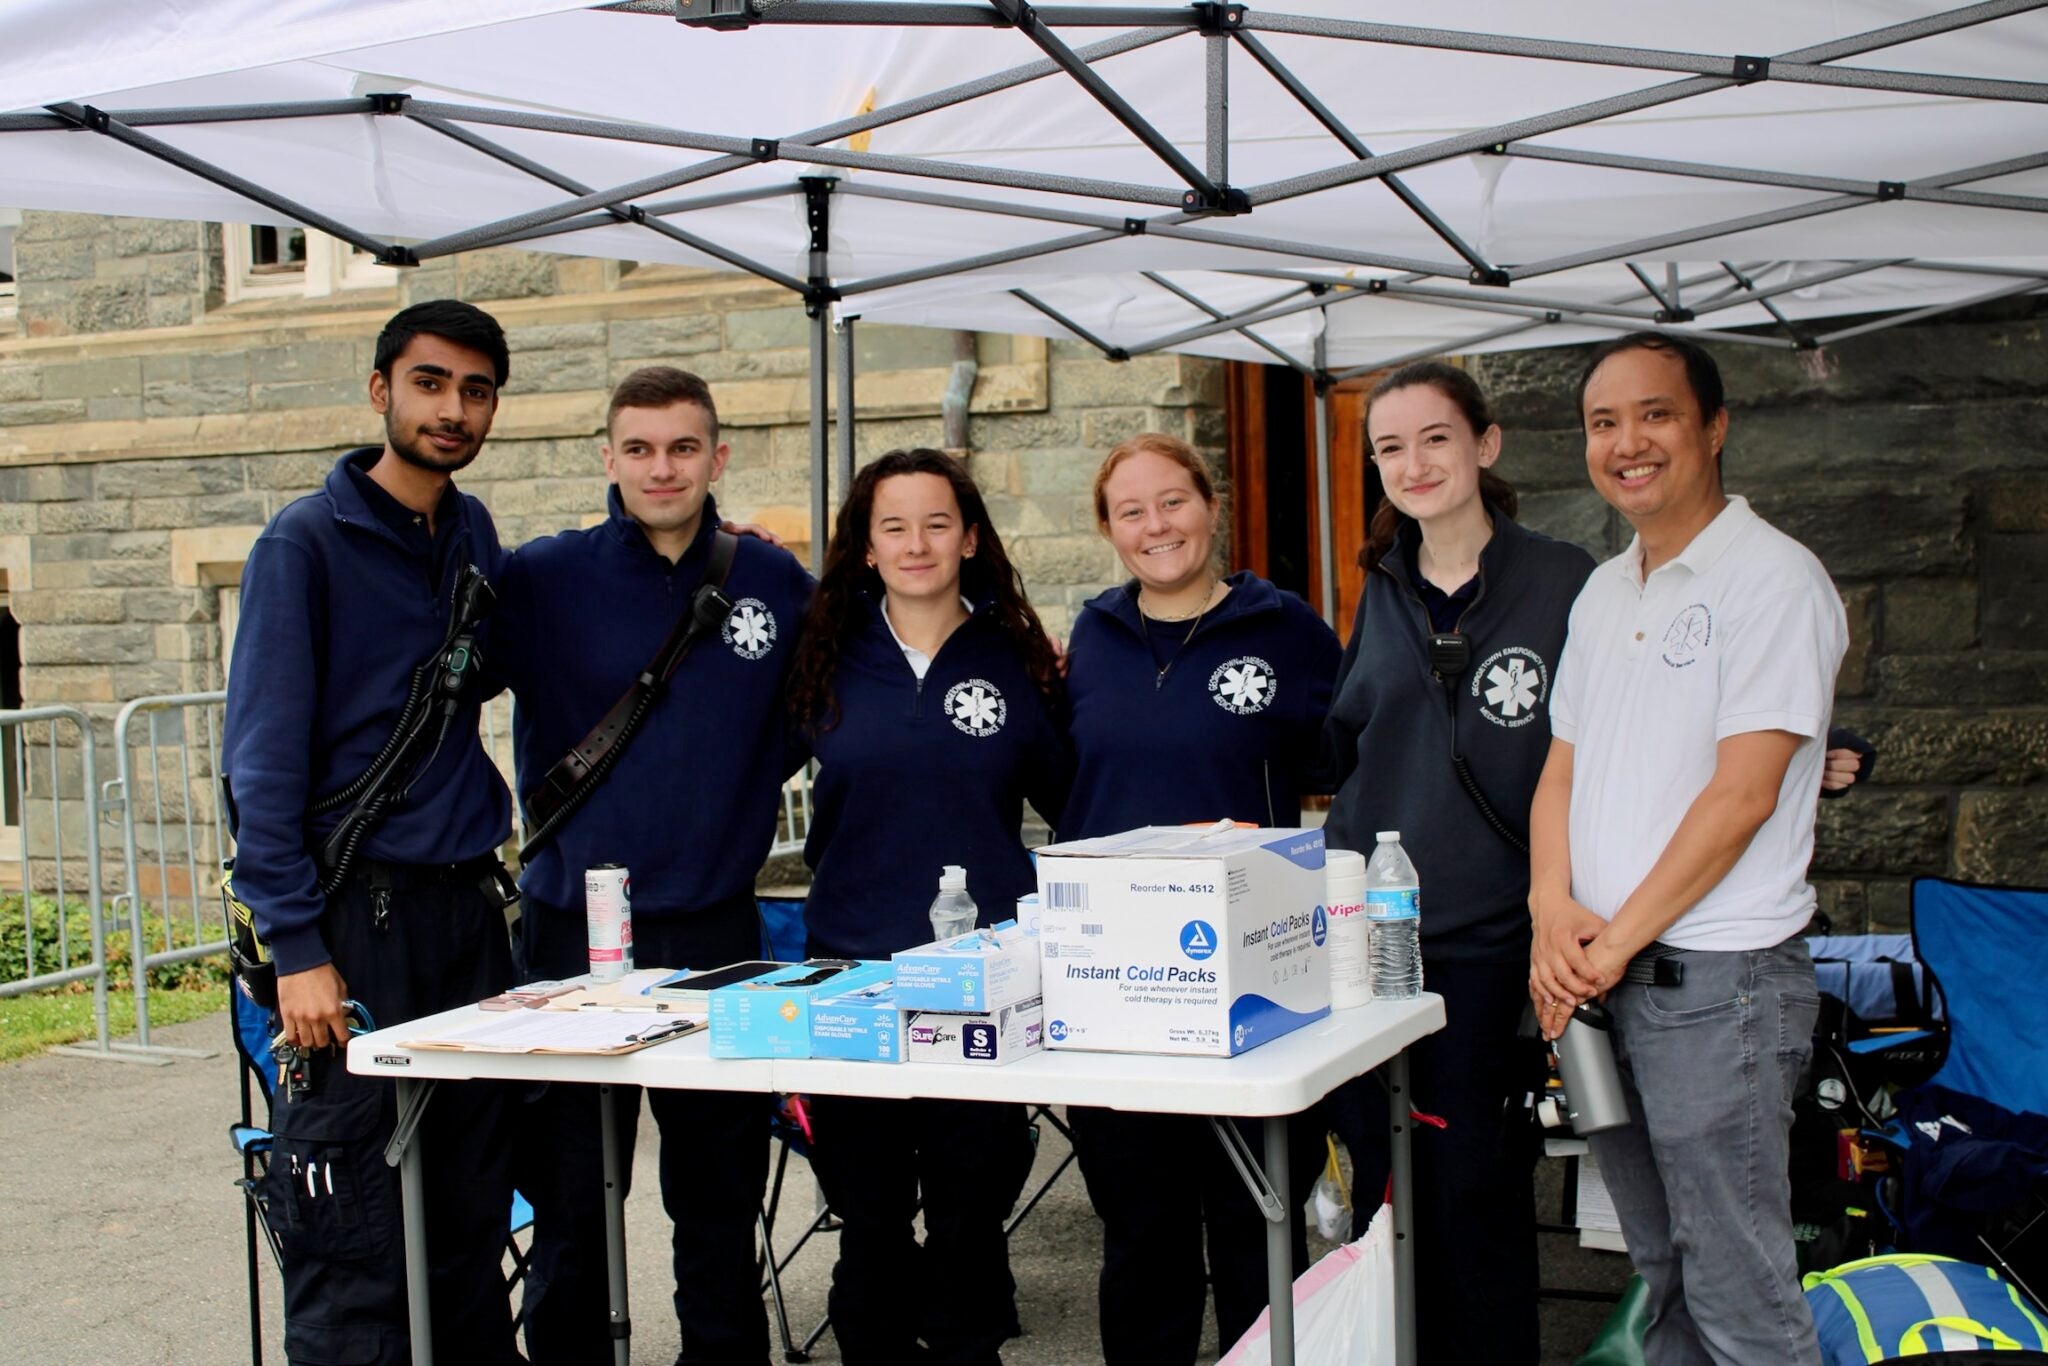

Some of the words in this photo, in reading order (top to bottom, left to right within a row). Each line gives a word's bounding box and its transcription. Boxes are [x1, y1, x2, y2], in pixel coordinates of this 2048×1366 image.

[1480, 706, 1507, 727] MEDICAL
[1130, 883, 1166, 893] Reorder
[1168, 884, 1186, 893] No.
[1188, 884, 1215, 893] 4512
[1242, 925, 1268, 948] Instant
[1270, 916, 1288, 938] Cold
[1289, 911, 1310, 932] Packs
[1066, 964, 1121, 980] Instant
[1127, 965, 1164, 981] Cold
[1167, 966, 1217, 983] Packs
[1118, 984, 1132, 992] For
[1150, 985, 1188, 993] whenever
[1189, 986, 1218, 994] instant
[1124, 995, 1142, 1003] cold
[1143, 996, 1173, 1005] therapy
[1174, 996, 1182, 1004] is
[1183, 997, 1218, 1006] required
[1051, 1024, 1067, 1036] 24
[973, 1028, 988, 1048] S
